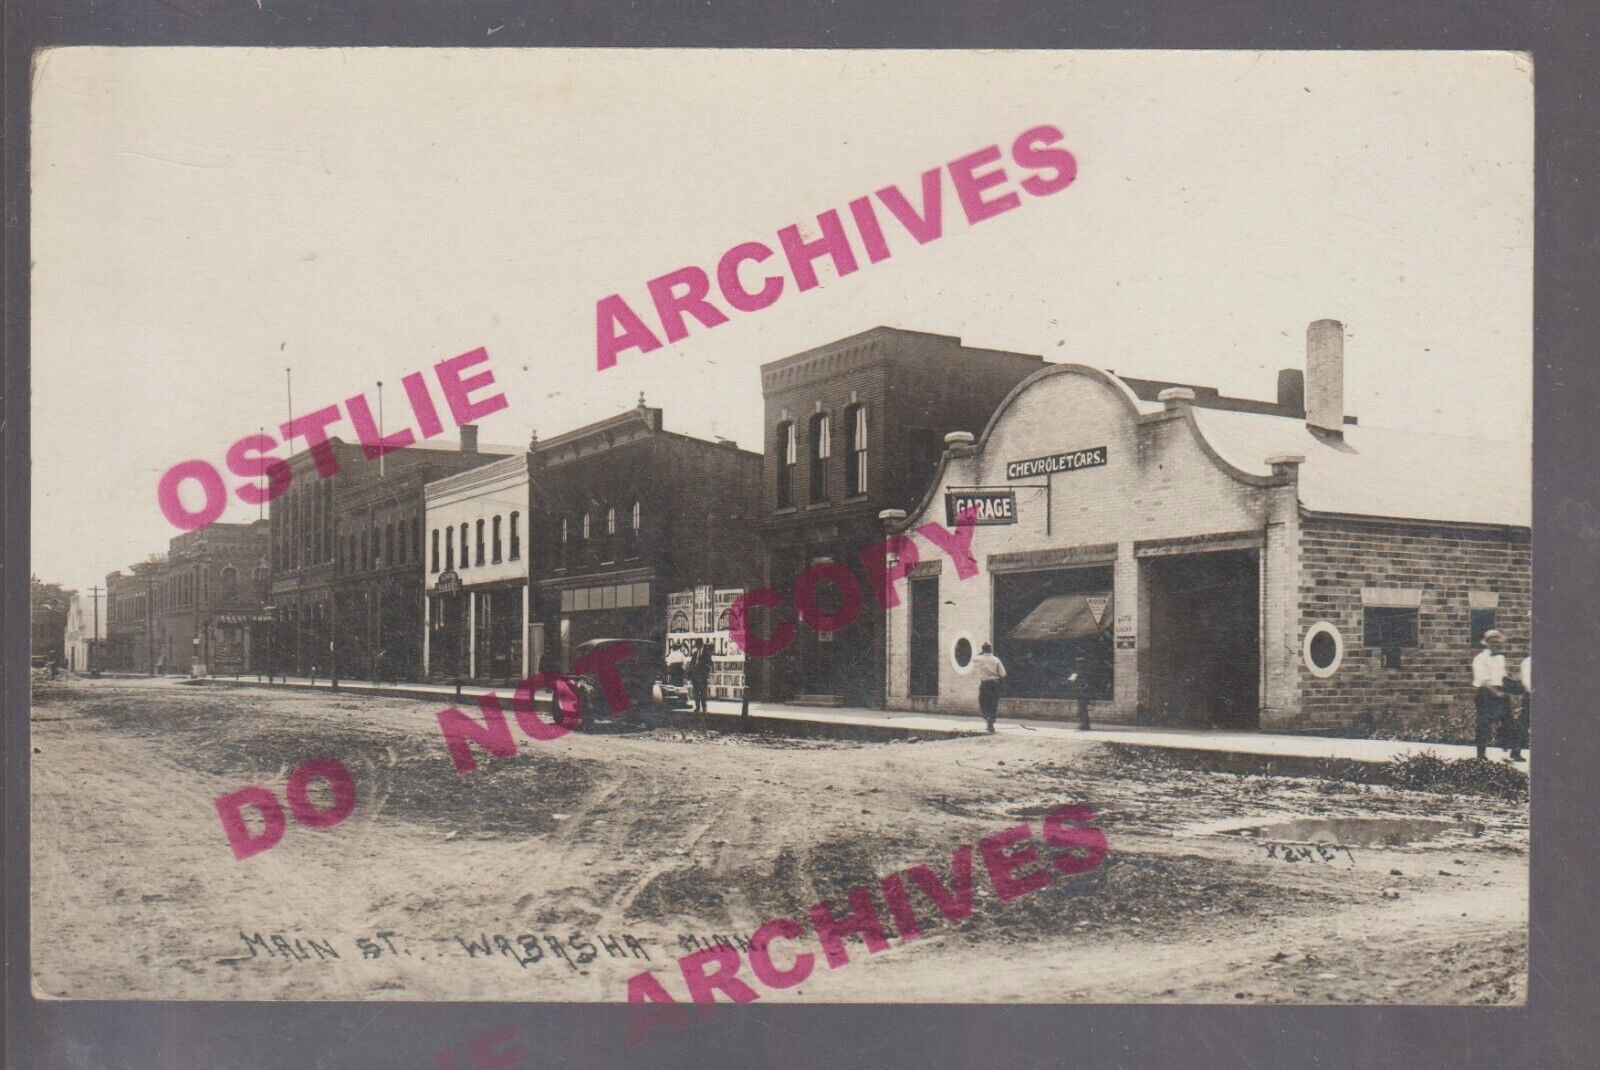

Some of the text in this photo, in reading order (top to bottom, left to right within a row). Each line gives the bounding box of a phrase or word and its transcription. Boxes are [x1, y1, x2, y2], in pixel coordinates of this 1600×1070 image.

[1008, 454, 1074, 478] CHEVROLET
[956, 498, 1012, 520] GARAGE
[239, 930, 341, 962] MAIN
[454, 932, 651, 970] WABASHA
